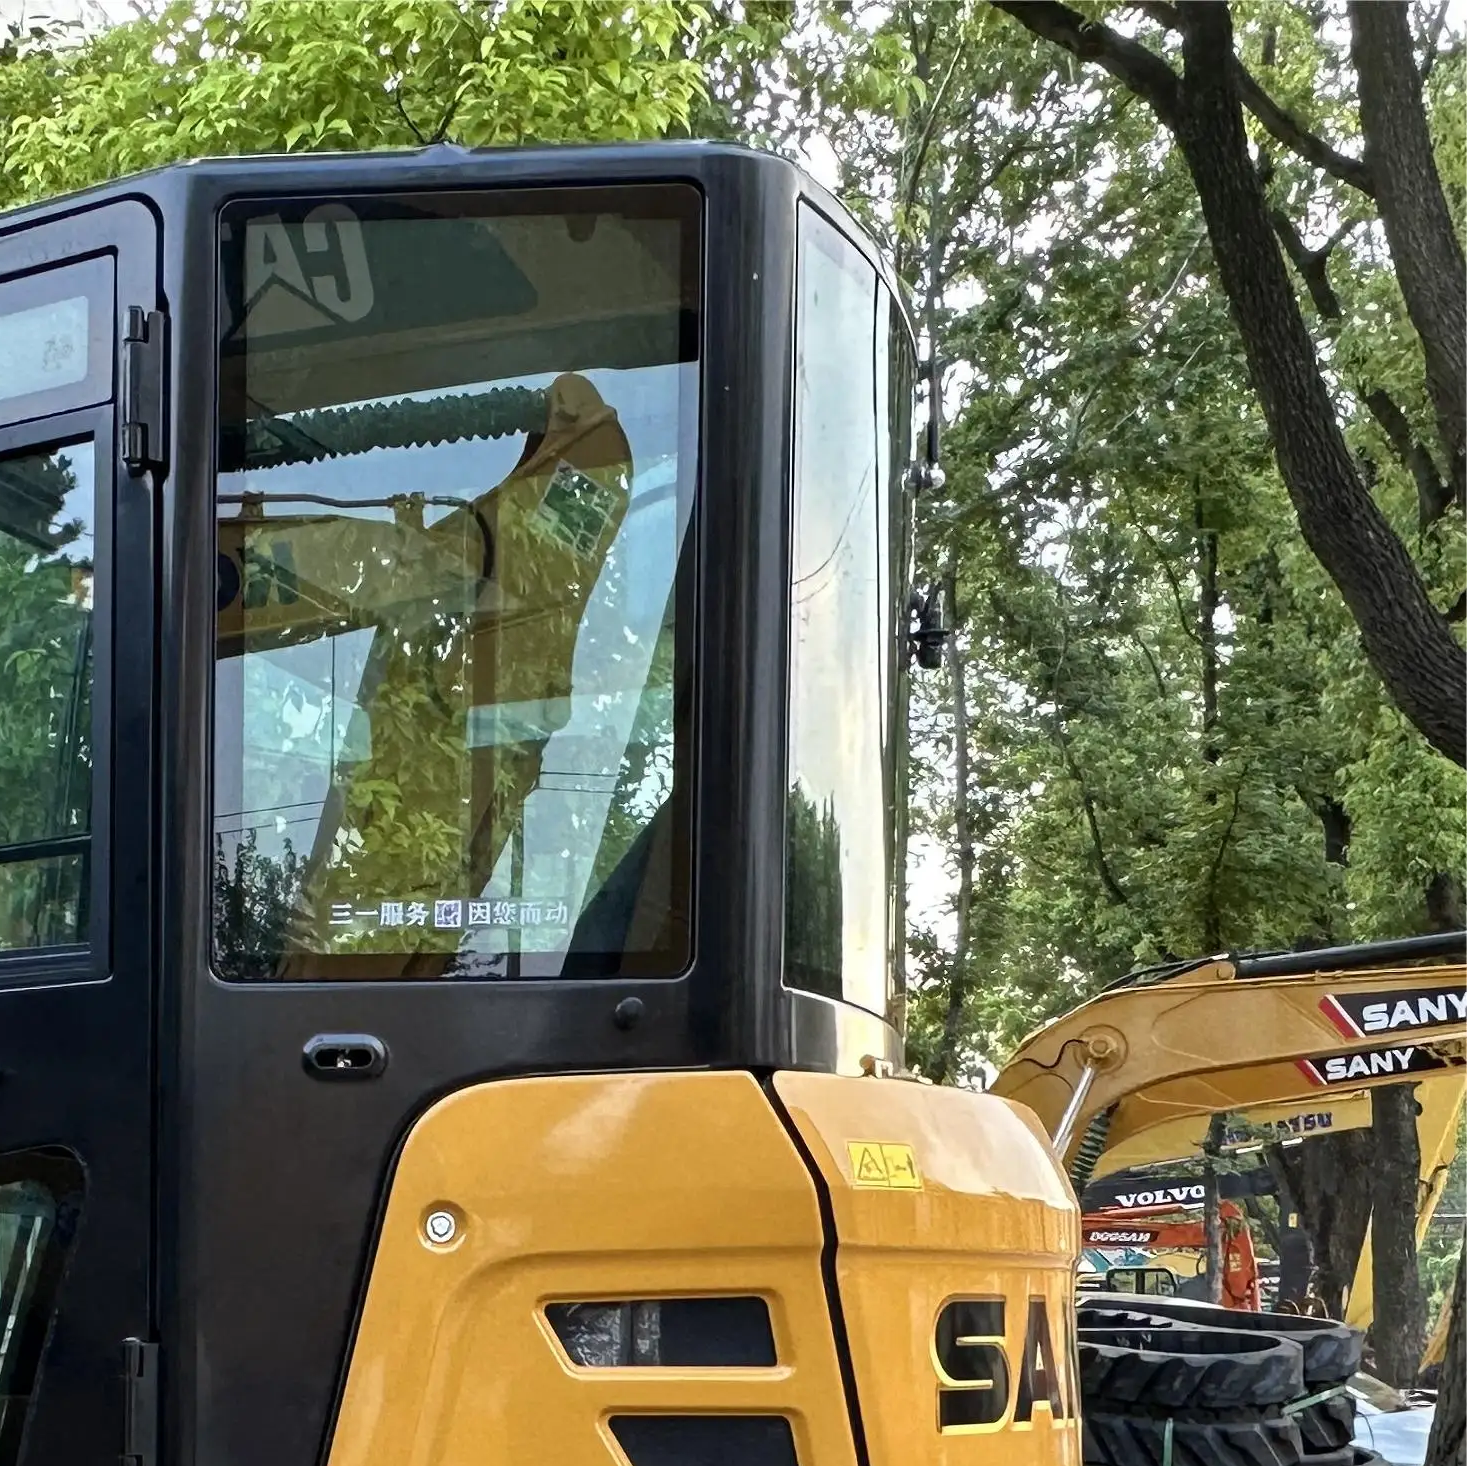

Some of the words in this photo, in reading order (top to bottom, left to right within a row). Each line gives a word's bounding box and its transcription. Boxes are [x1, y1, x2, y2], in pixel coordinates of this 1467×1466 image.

[329, 902, 430, 927] 三一服务
[468, 902, 568, 926] 因您而动
[1361, 993, 1467, 1032] SANY
[1325, 1047, 1415, 1081] SANY
[1114, 1184, 1205, 1208] VOLVO
[931, 1294, 1077, 1436] SA
